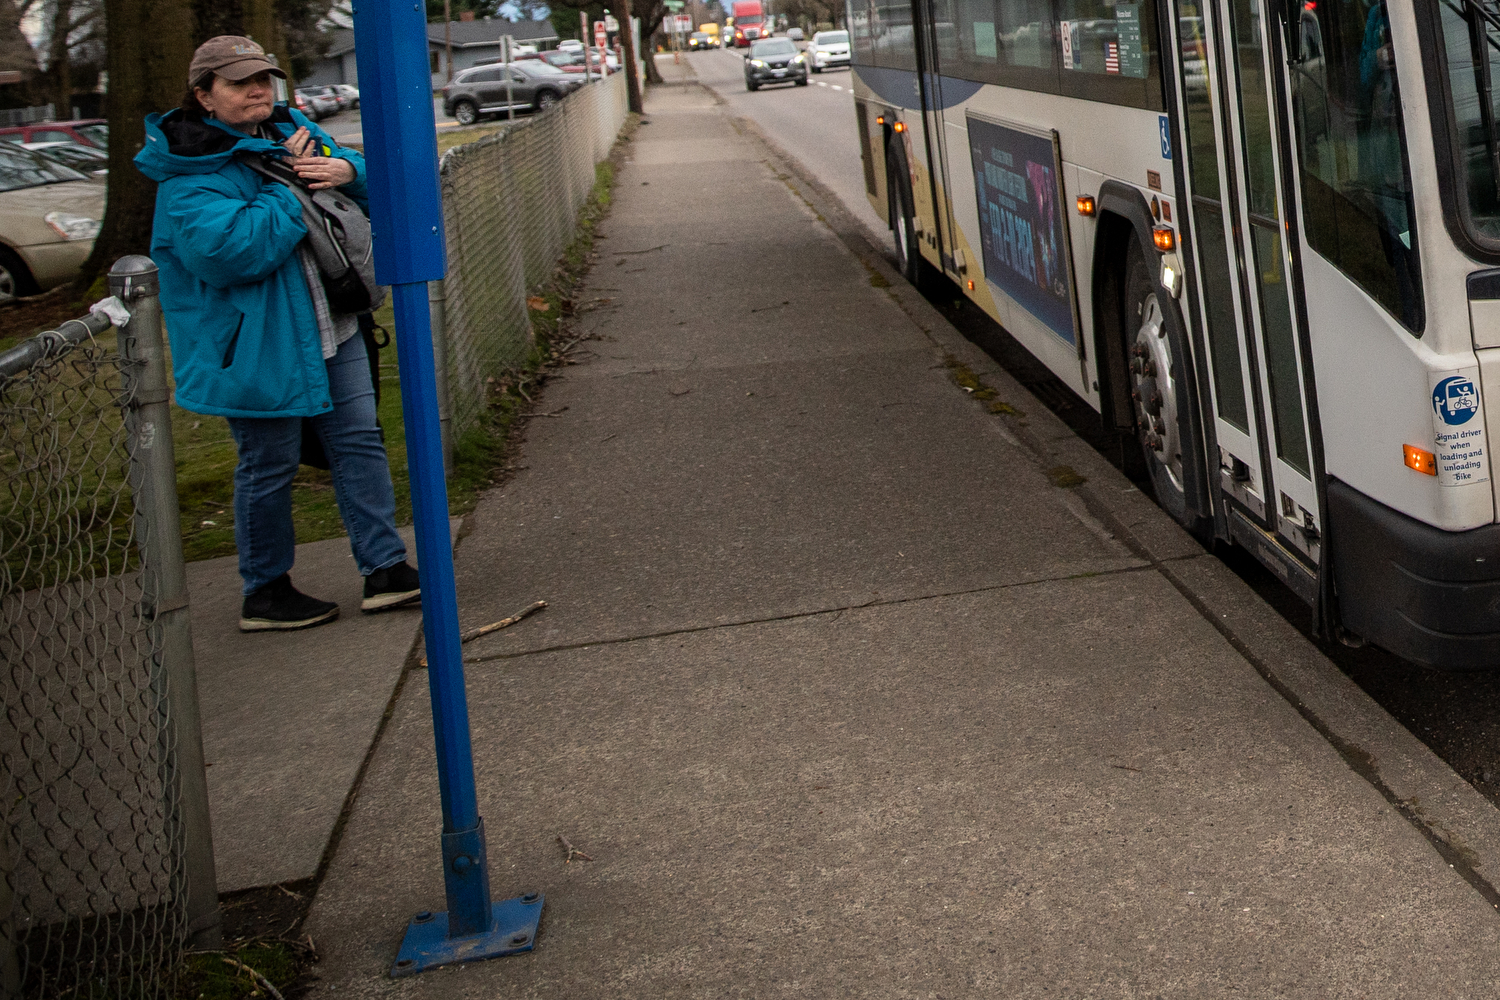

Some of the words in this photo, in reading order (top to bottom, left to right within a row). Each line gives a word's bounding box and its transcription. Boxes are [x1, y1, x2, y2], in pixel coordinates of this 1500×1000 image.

[1436, 432, 1460, 442] Signal
[1460, 430, 1482, 439] driver
[1450, 442, 1471, 450] when
[1439, 453, 1468, 461] loading
[1468, 448, 1483, 458] and
[1443, 461, 1481, 472] unloading
[1455, 472, 1472, 480] bike
